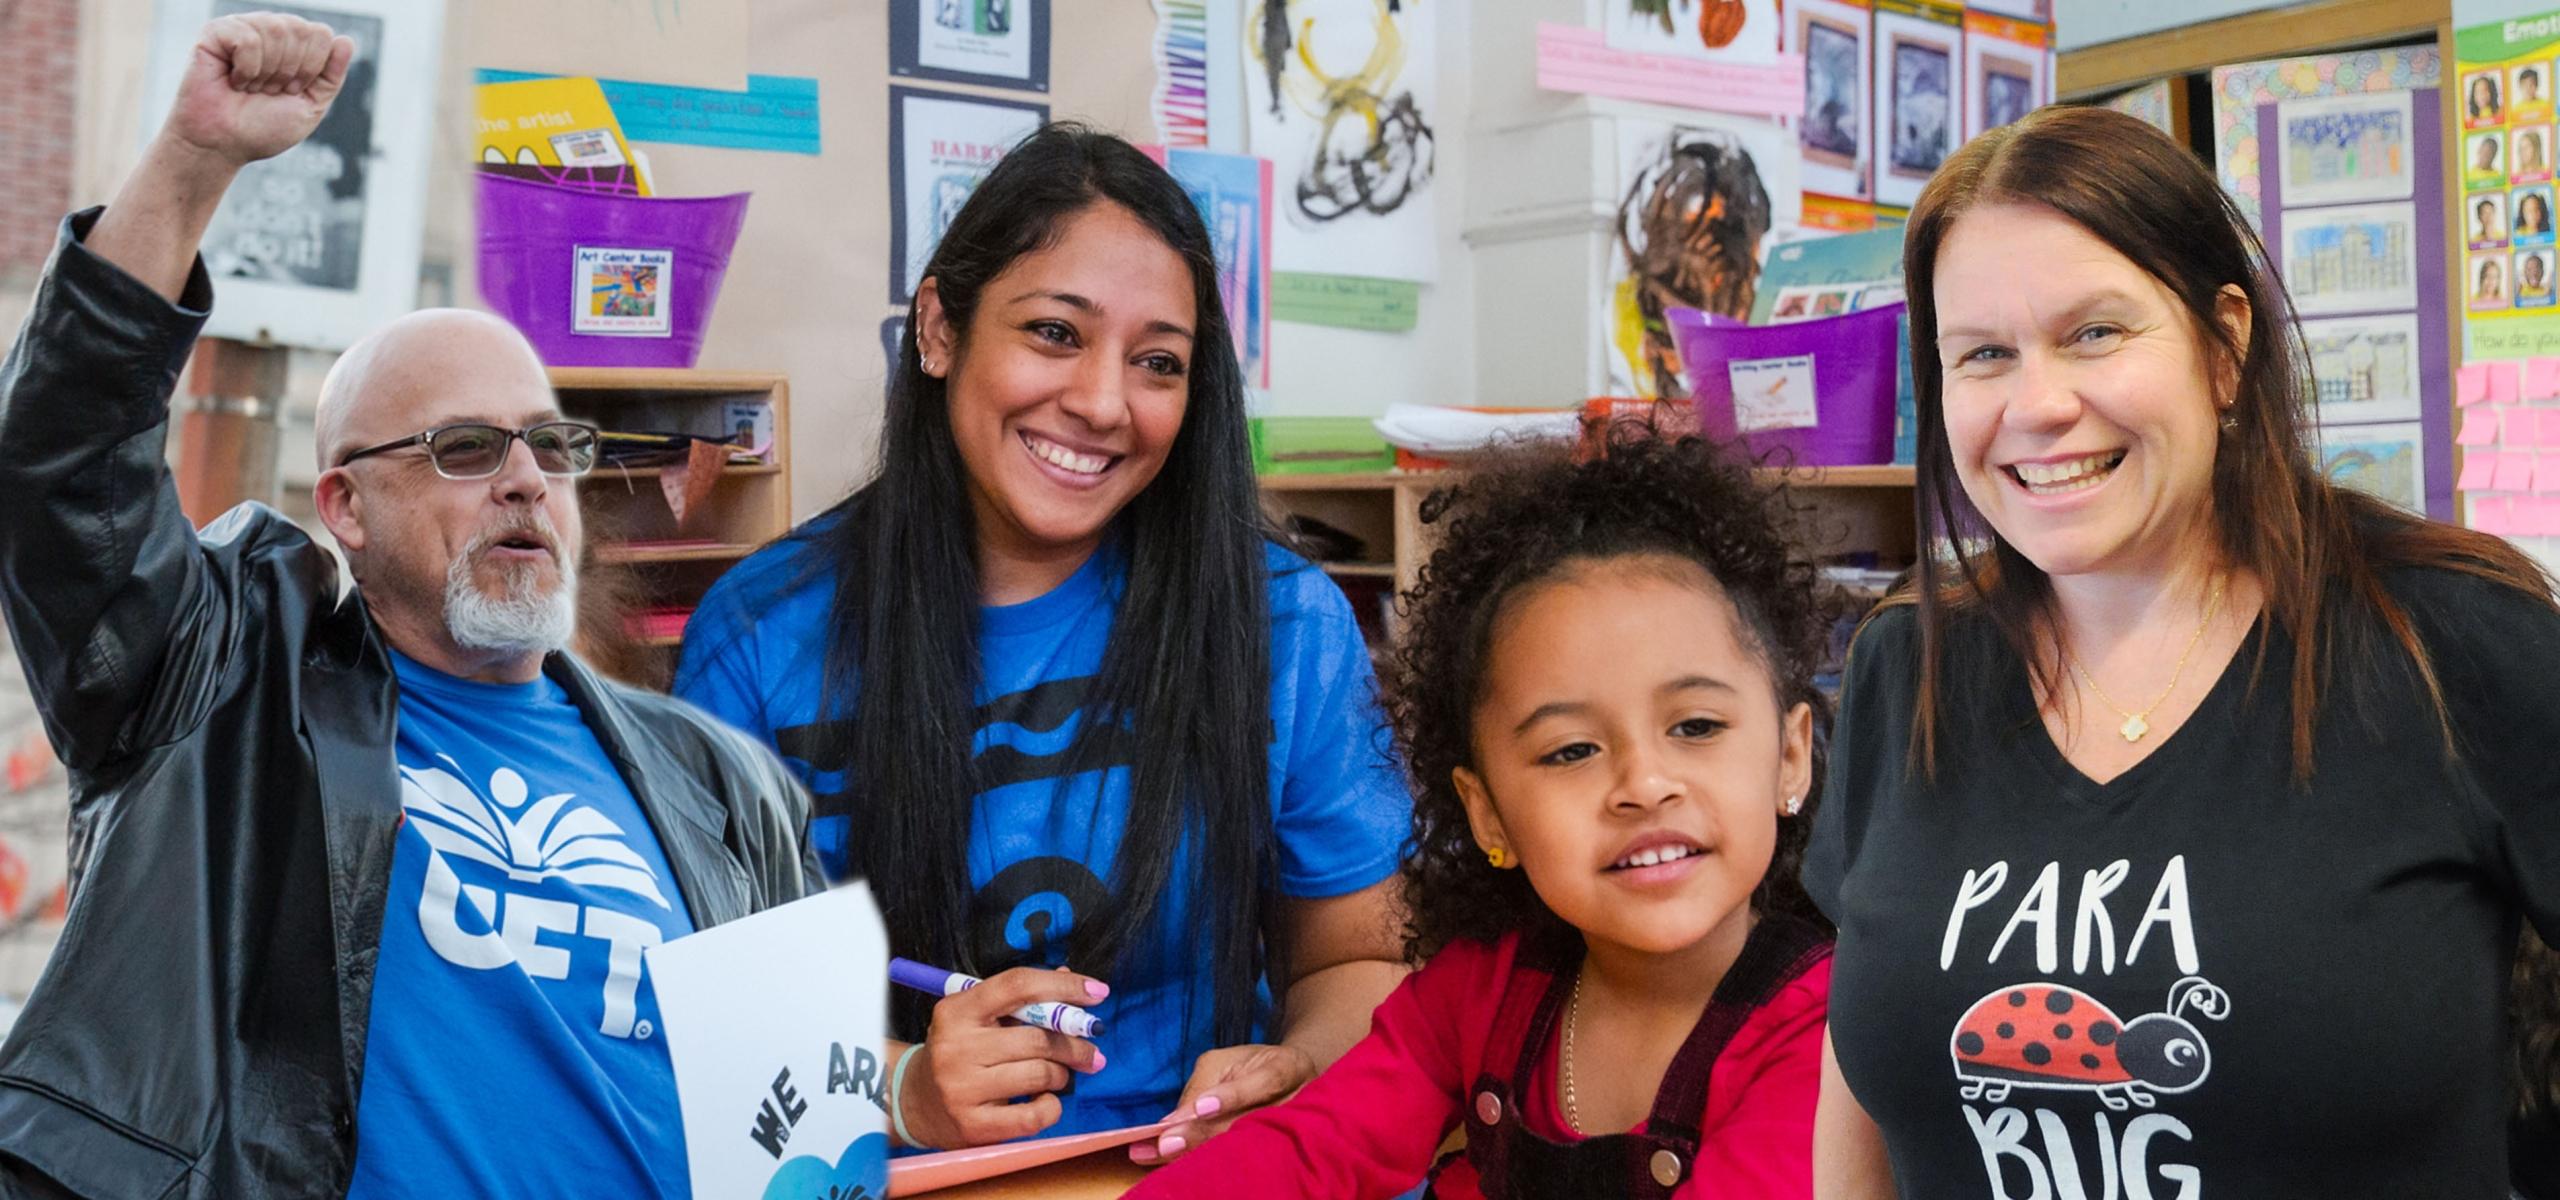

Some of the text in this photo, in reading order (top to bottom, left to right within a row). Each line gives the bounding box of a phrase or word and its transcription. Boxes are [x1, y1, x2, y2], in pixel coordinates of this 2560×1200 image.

[517, 110, 575, 129] artist
[581, 251, 666, 264] Art Center Books
[418, 843, 664, 1039] UFT
[1940, 854, 2200, 976] PARA
[750, 1064, 809, 1161] WE
[1961, 1104, 2201, 1200] BUG
